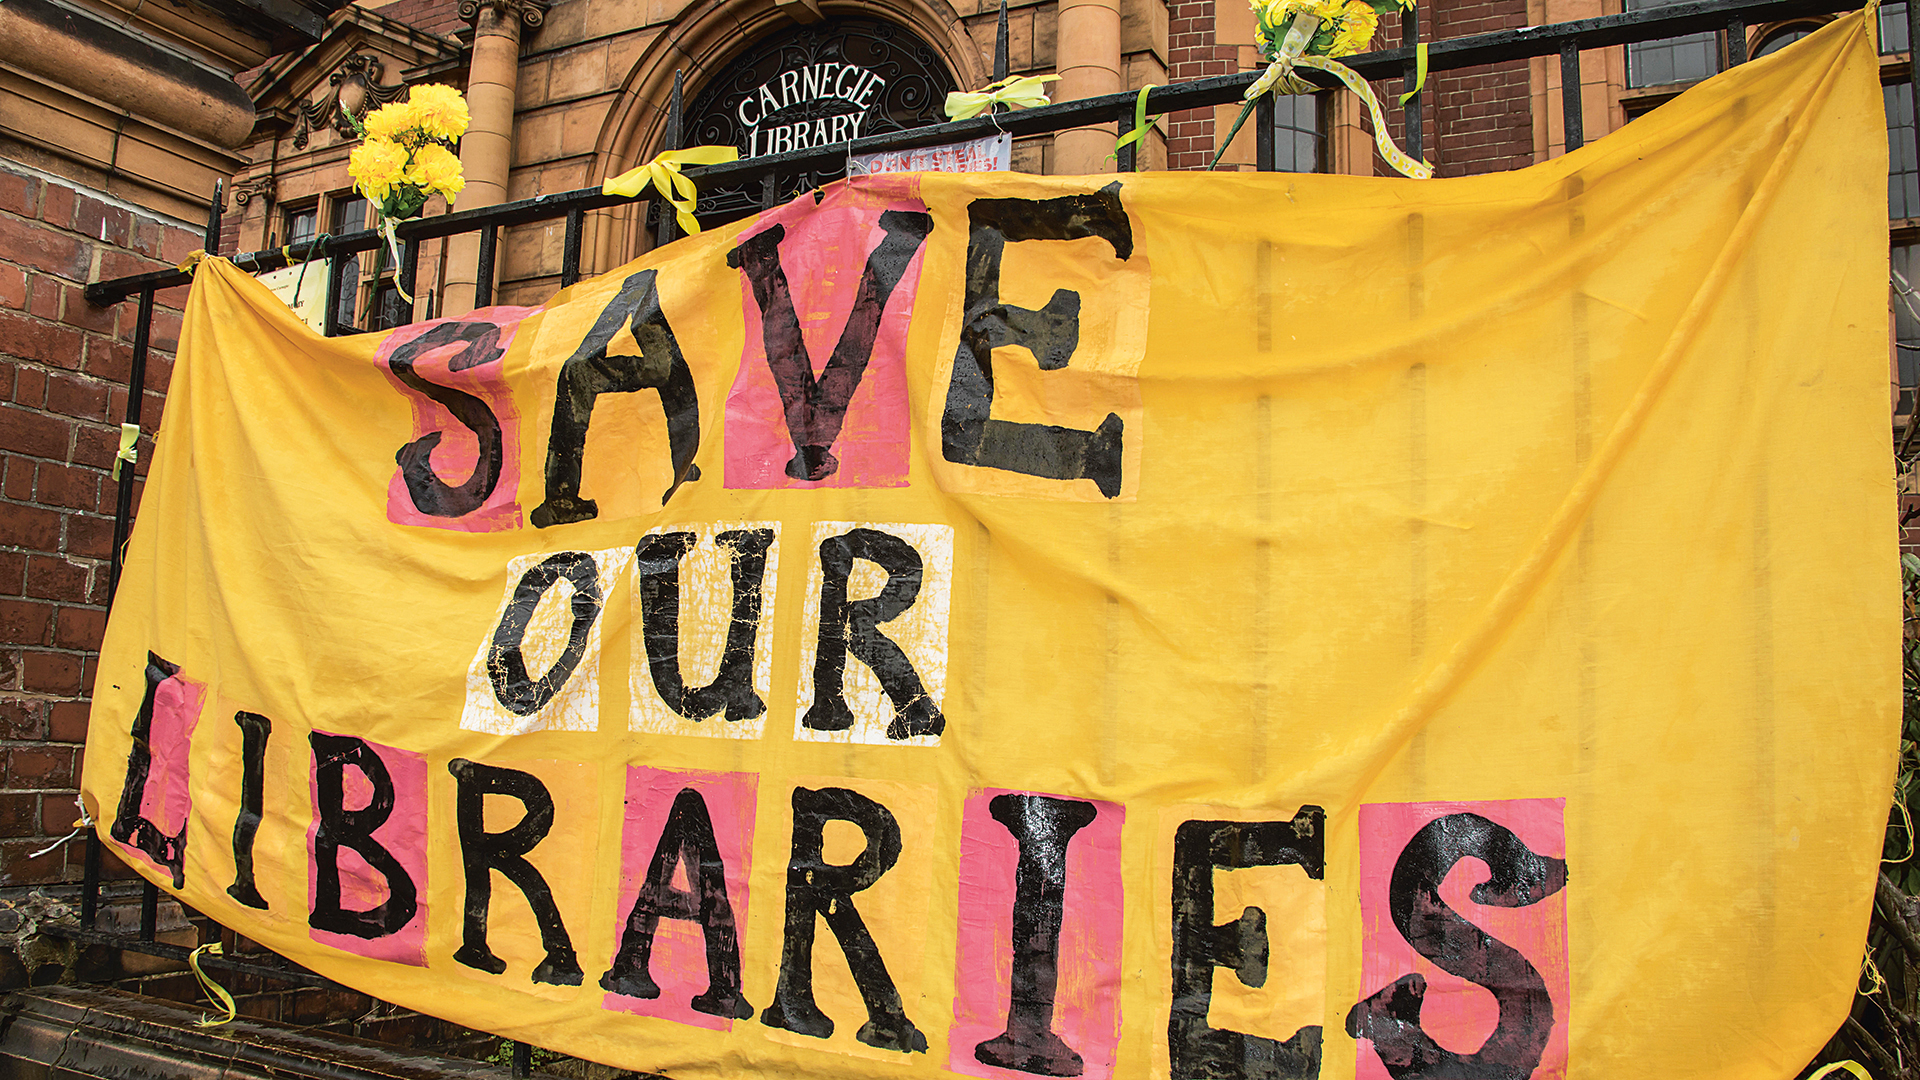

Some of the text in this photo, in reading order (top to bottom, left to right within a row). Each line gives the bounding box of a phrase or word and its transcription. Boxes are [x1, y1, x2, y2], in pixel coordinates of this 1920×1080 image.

[738, 62, 886, 127] CARNEGIE
[749, 111, 867, 159] LIBRARY
[870, 144, 987, 174] DON'T STEAL
[394, 180, 1134, 529] SAVE
[486, 528, 946, 741] OUR
[110, 650, 1569, 1080] LIBRARIES
